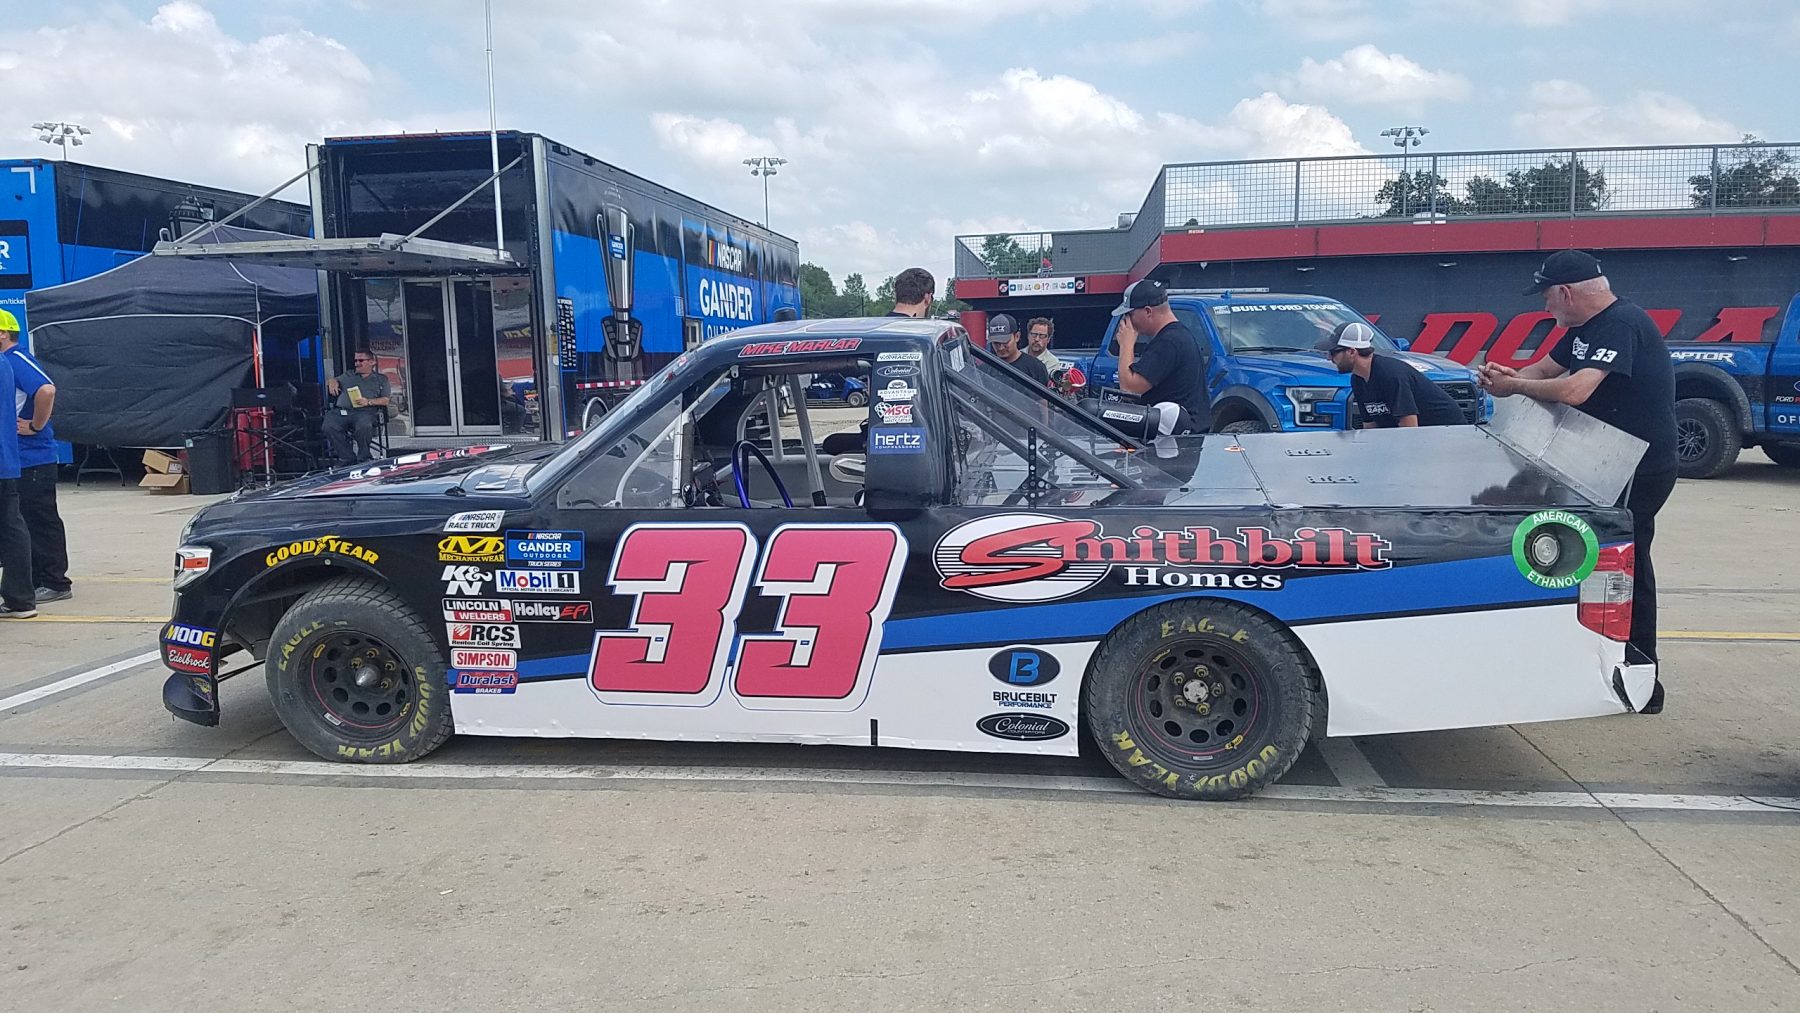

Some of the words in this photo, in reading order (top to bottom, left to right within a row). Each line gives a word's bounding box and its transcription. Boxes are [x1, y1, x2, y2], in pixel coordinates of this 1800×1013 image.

[717, 242, 742, 273] NASCAR
[700, 278, 753, 321] GANDER
[1231, 304, 1268, 313] BUILT
[741, 342, 785, 356] MIKE
[785, 337, 862, 354] MARLAR
[1590, 347, 1618, 363] 33
[1670, 351, 1738, 367] APTOR
[884, 366, 913, 375] Colonial
[884, 405, 911, 416] MSG
[875, 432, 921, 446] hertz
[463, 512, 497, 521] NASCAR
[1532, 511, 1591, 535] AMERICAN
[471, 521, 496, 529] TRUCK
[535, 532, 562, 540] NASCAR
[265, 535, 380, 568] GOODYEAR
[518, 542, 571, 553] GANDER
[940, 519, 1392, 590] Smithbilt
[480, 554, 505, 562] WEAR
[500, 571, 551, 589] Mobil
[1123, 565, 1284, 590] Homes
[1526, 571, 1582, 589] ETHANOL
[446, 600, 499, 610] LINCOLN
[515, 602, 561, 621] Holley
[458, 612, 506, 621] WELDERS
[587, 520, 909, 711] 33
[165, 625, 217, 648] MOOG
[470, 625, 515, 642] RCS
[168, 649, 210, 669] Edelbrock
[456, 652, 511, 667] SIMPSON
[1008, 652, 1041, 683] B
[460, 673, 514, 685] Duralast
[992, 691, 1058, 704] BRUCEBILT
[998, 700, 1053, 709] PERFORMANCE
[995, 717, 1051, 733] Colonial
